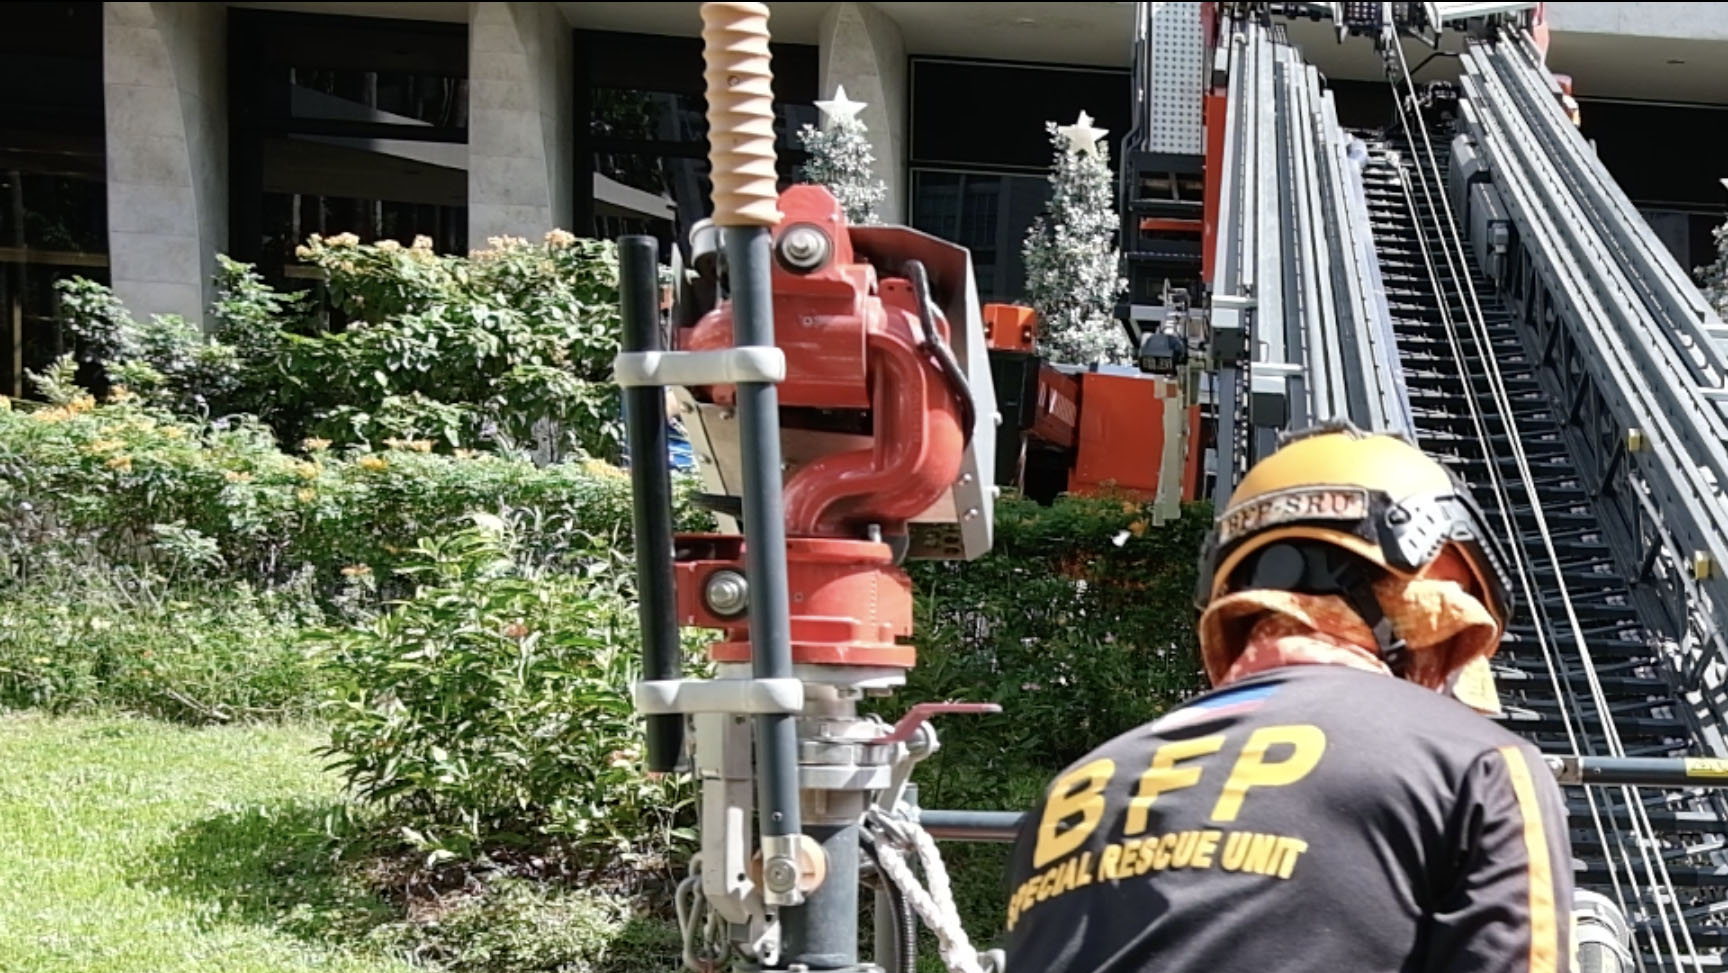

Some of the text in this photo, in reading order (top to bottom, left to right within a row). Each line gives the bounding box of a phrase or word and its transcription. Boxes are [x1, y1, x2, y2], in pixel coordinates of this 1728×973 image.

[1033, 724, 1327, 869] BFP
[1007, 830, 1309, 932] SPECIAL RESCUE UNIT
